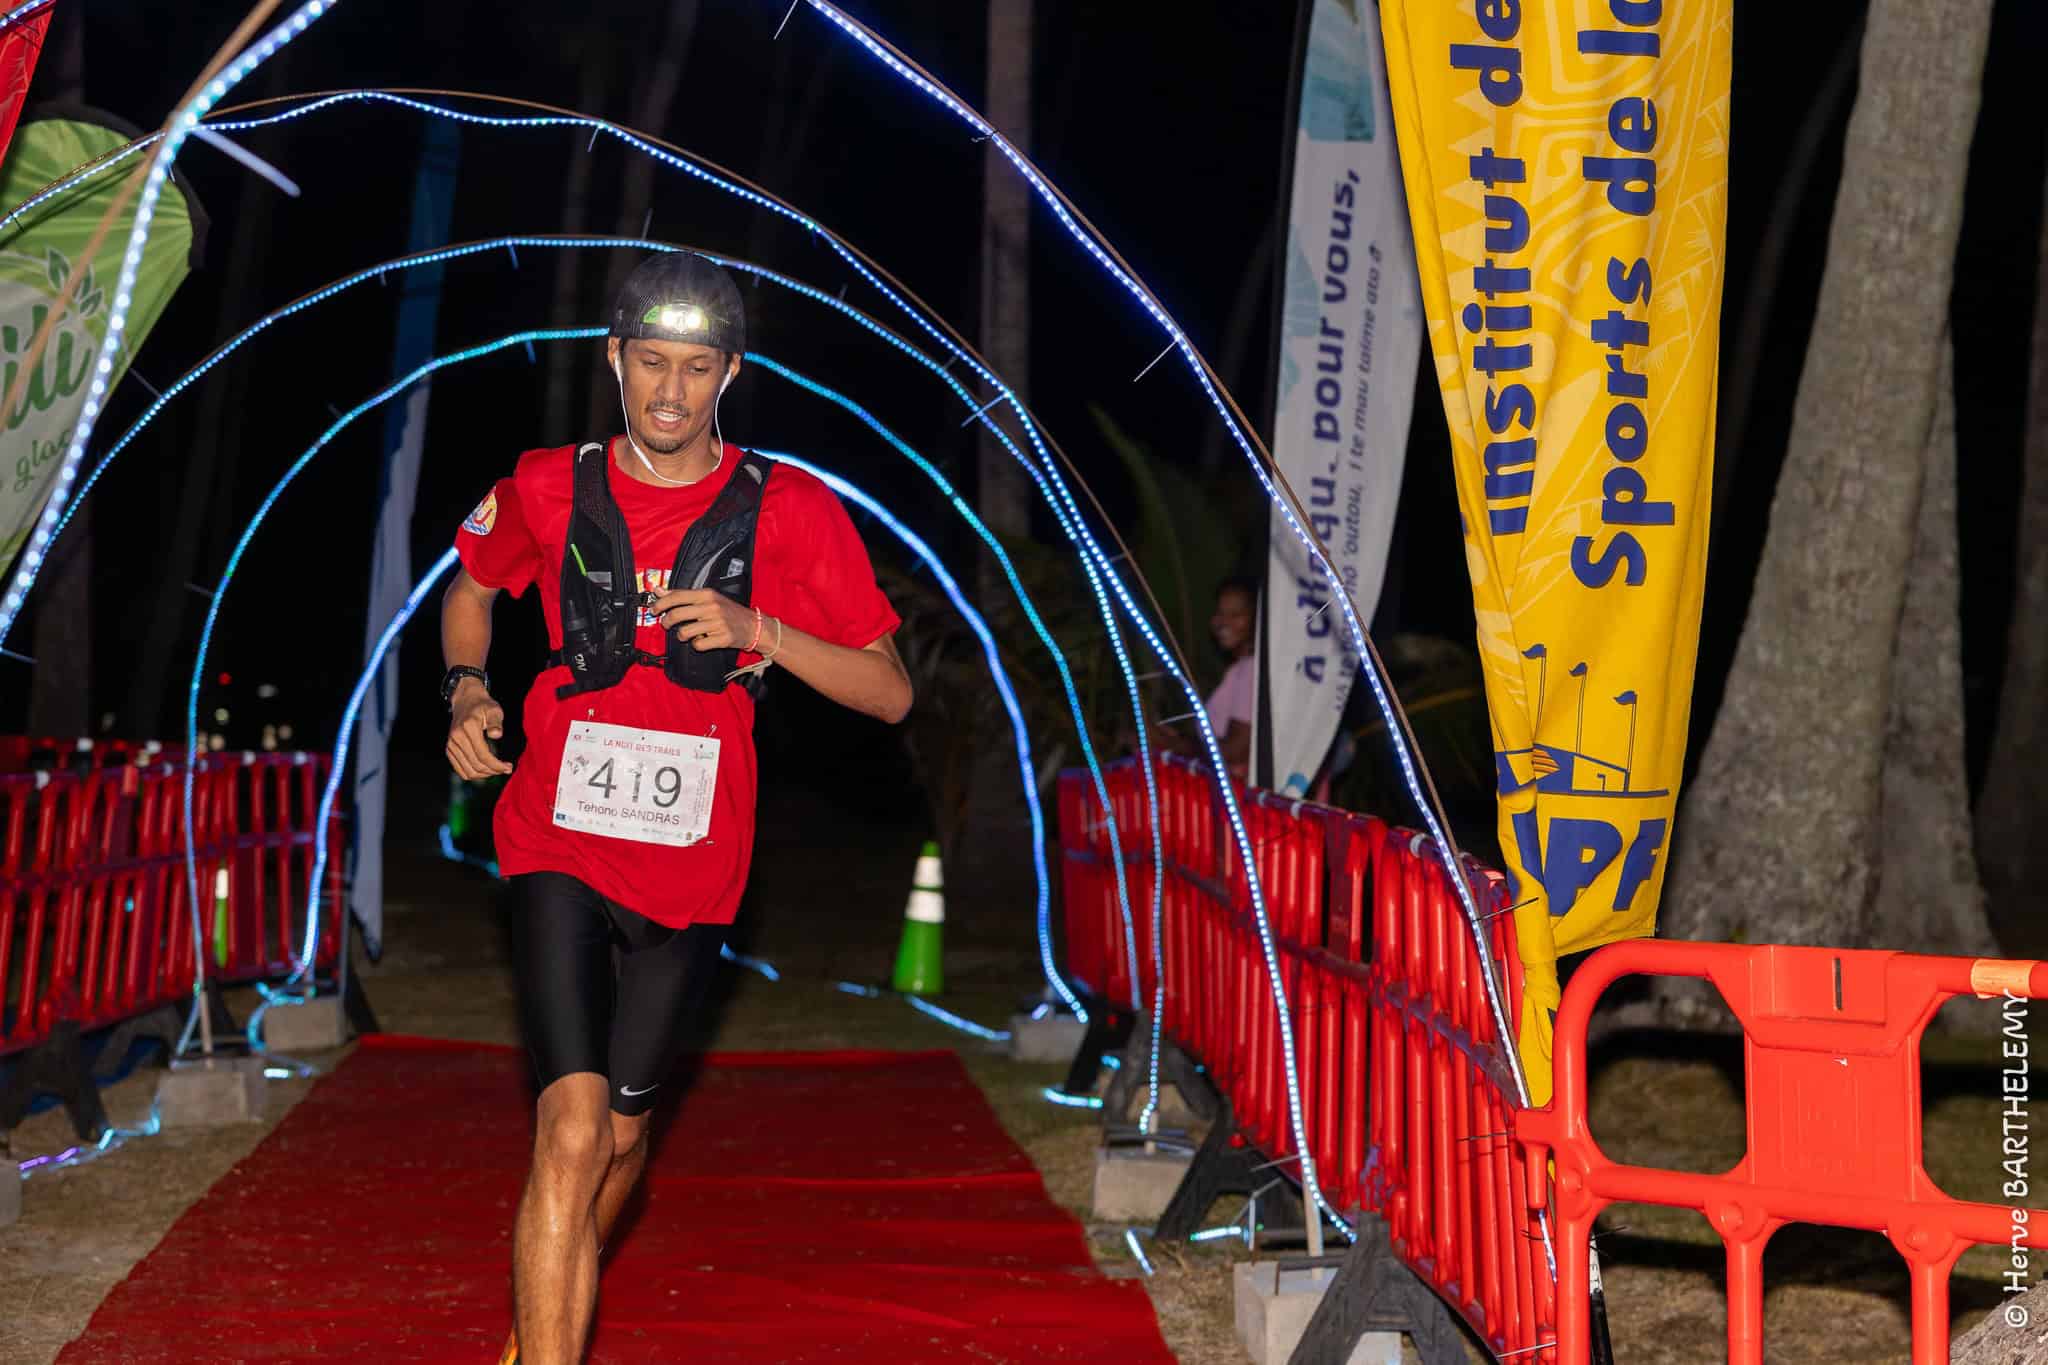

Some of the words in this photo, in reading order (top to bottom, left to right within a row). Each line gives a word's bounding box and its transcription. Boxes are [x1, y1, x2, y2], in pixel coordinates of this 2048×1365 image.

[1450, 0, 1523, 107] de
[1583, 97, 1658, 217] de
[1323, 169, 1360, 303] vous,
[1313, 316, 1345, 443] pour
[1357, 308, 1375, 374] taime
[1461, 147, 1537, 536] Institut
[1350, 434, 1365, 457] te
[1354, 379, 1369, 431] mau
[1570, 256, 1675, 589] Sports
[587, 757, 682, 808] 419
[620, 806, 681, 826] SANDRAS
